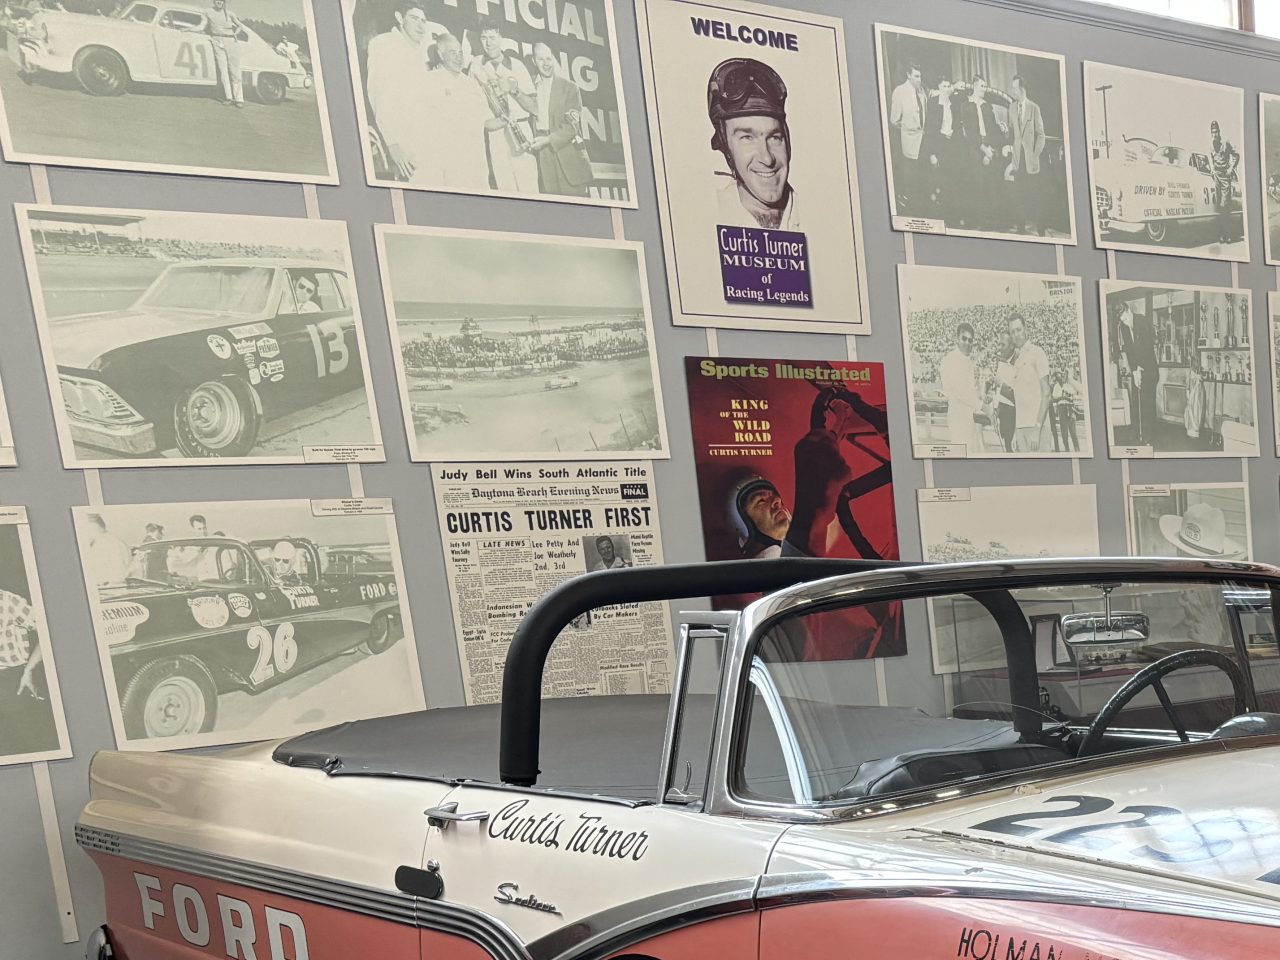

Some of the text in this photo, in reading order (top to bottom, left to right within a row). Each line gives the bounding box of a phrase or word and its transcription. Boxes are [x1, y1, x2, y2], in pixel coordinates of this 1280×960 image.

[691, 17, 799, 51] WELCOME
[174, 42, 208, 78] 41
[1134, 185, 1165, 196] DRIVEN BY
[720, 228, 804, 257] Curtis Turner
[722, 254, 806, 271] MUSEUM
[761, 273, 773, 284] of
[726, 285, 809, 303] Racing Legends
[305, 321, 349, 378] 13
[700, 360, 871, 381] Sports Illustrated
[731, 399, 769, 410] KING
[733, 420, 770, 430] WILD
[734, 432, 771, 442] ROAD
[740, 448, 773, 456] TURNER
[440, 466, 647, 481] Judy Bell Wins South Atlantic Title
[471, 487, 515, 500] Daytona
[517, 486, 548, 498] Beach
[549, 485, 590, 497] Evening
[592, 485, 619, 495] News
[623, 488, 646, 496] FINAL
[446, 506, 651, 534] CURTIS TURNER FIRST
[531, 538, 580, 549] Lee Petty And
[533, 551, 577, 560] Joe Weatherly
[554, 562, 566, 570] 3rd
[360, 582, 386, 600] FORD
[487, 603, 522, 611] Indonesian
[488, 611, 516, 619] Bombing
[247, 622, 298, 685] 26
[488, 799, 649, 863] Curtis Turner
